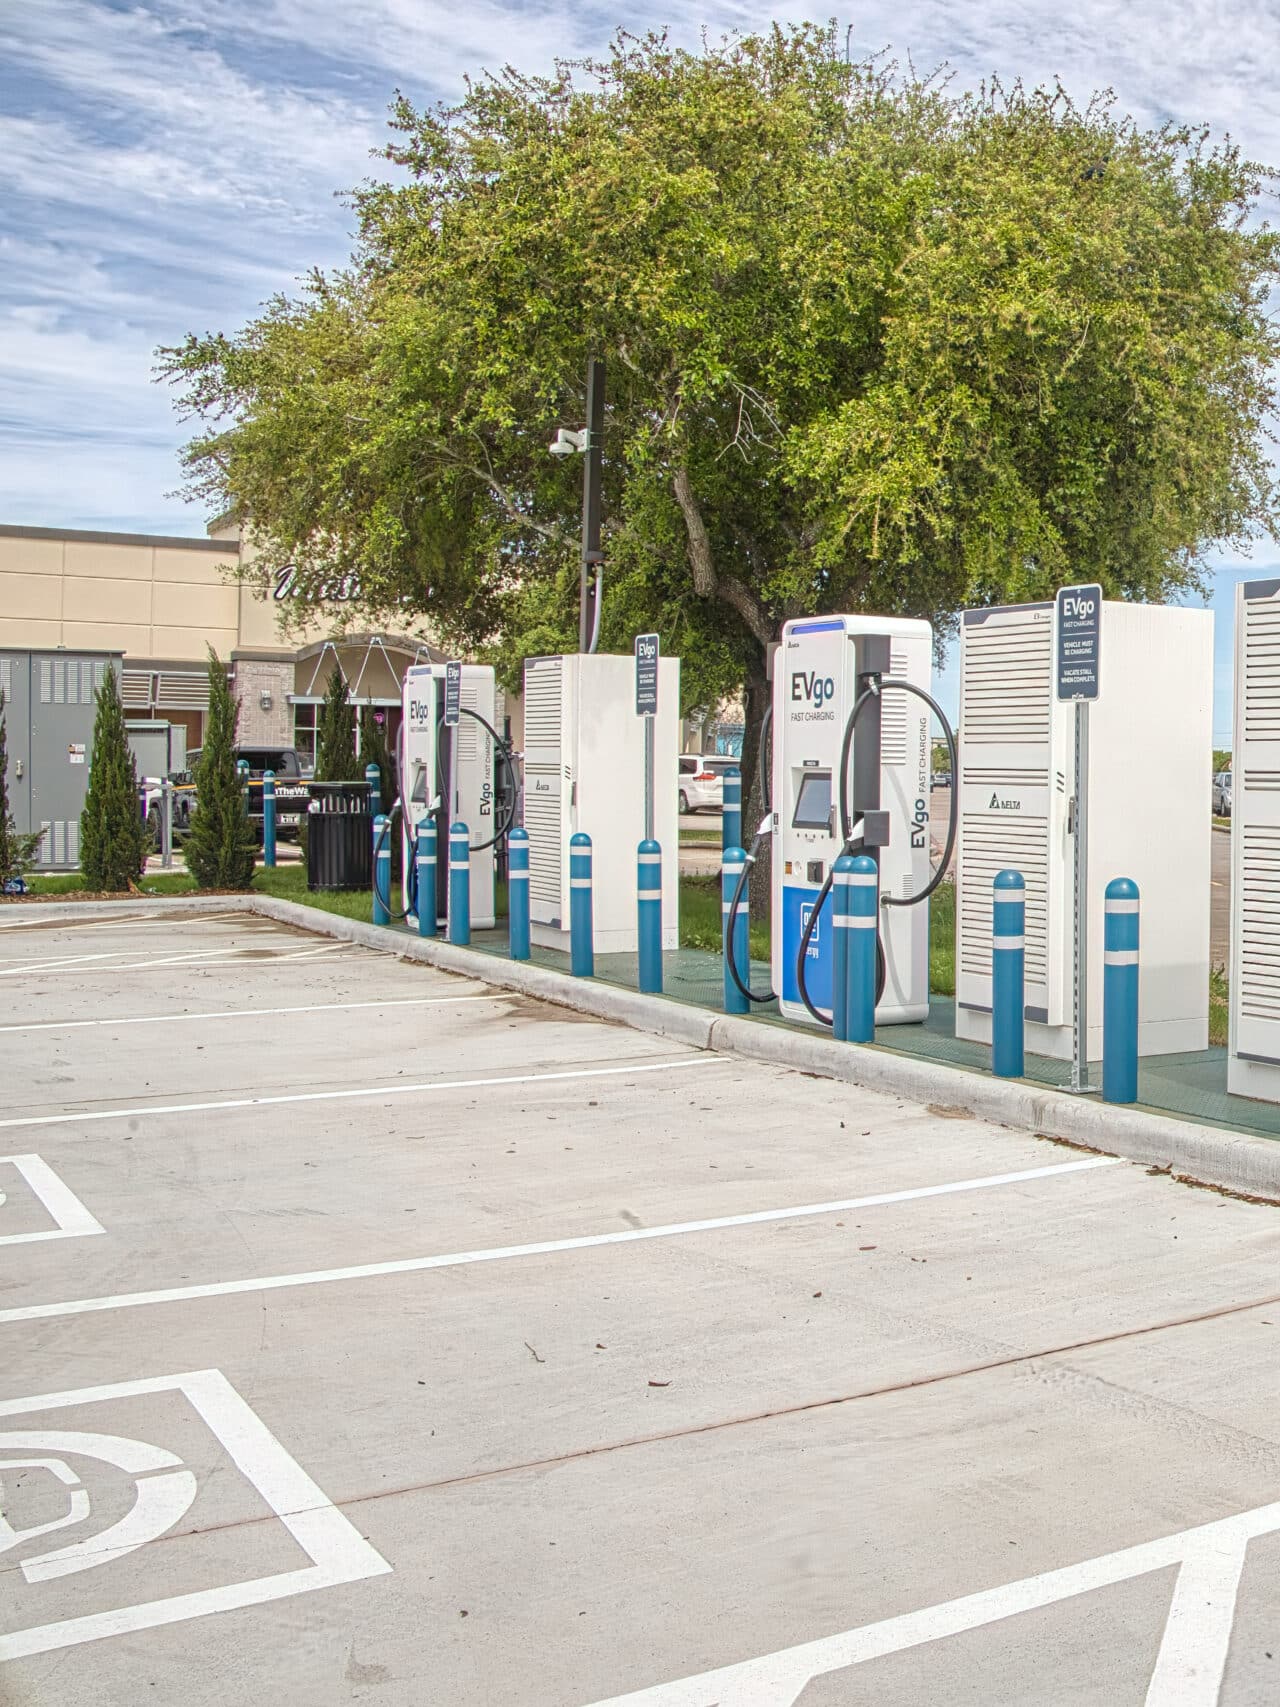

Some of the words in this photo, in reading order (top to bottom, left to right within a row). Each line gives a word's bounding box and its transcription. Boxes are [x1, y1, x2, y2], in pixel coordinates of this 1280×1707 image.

[1063, 597, 1094, 619] EVgo
[638, 643, 656, 658] EVgo
[792, 671, 834, 708] EVgo
[411, 700, 428, 724] EVgo
[791, 712, 804, 722] FAST
[804, 711, 835, 721] CHARGING
[919, 717, 927, 768] CHARGING
[480, 783, 493, 816] EVgo
[1001, 800, 1020, 809] DELTA
[911, 799, 929, 849] EVgo
